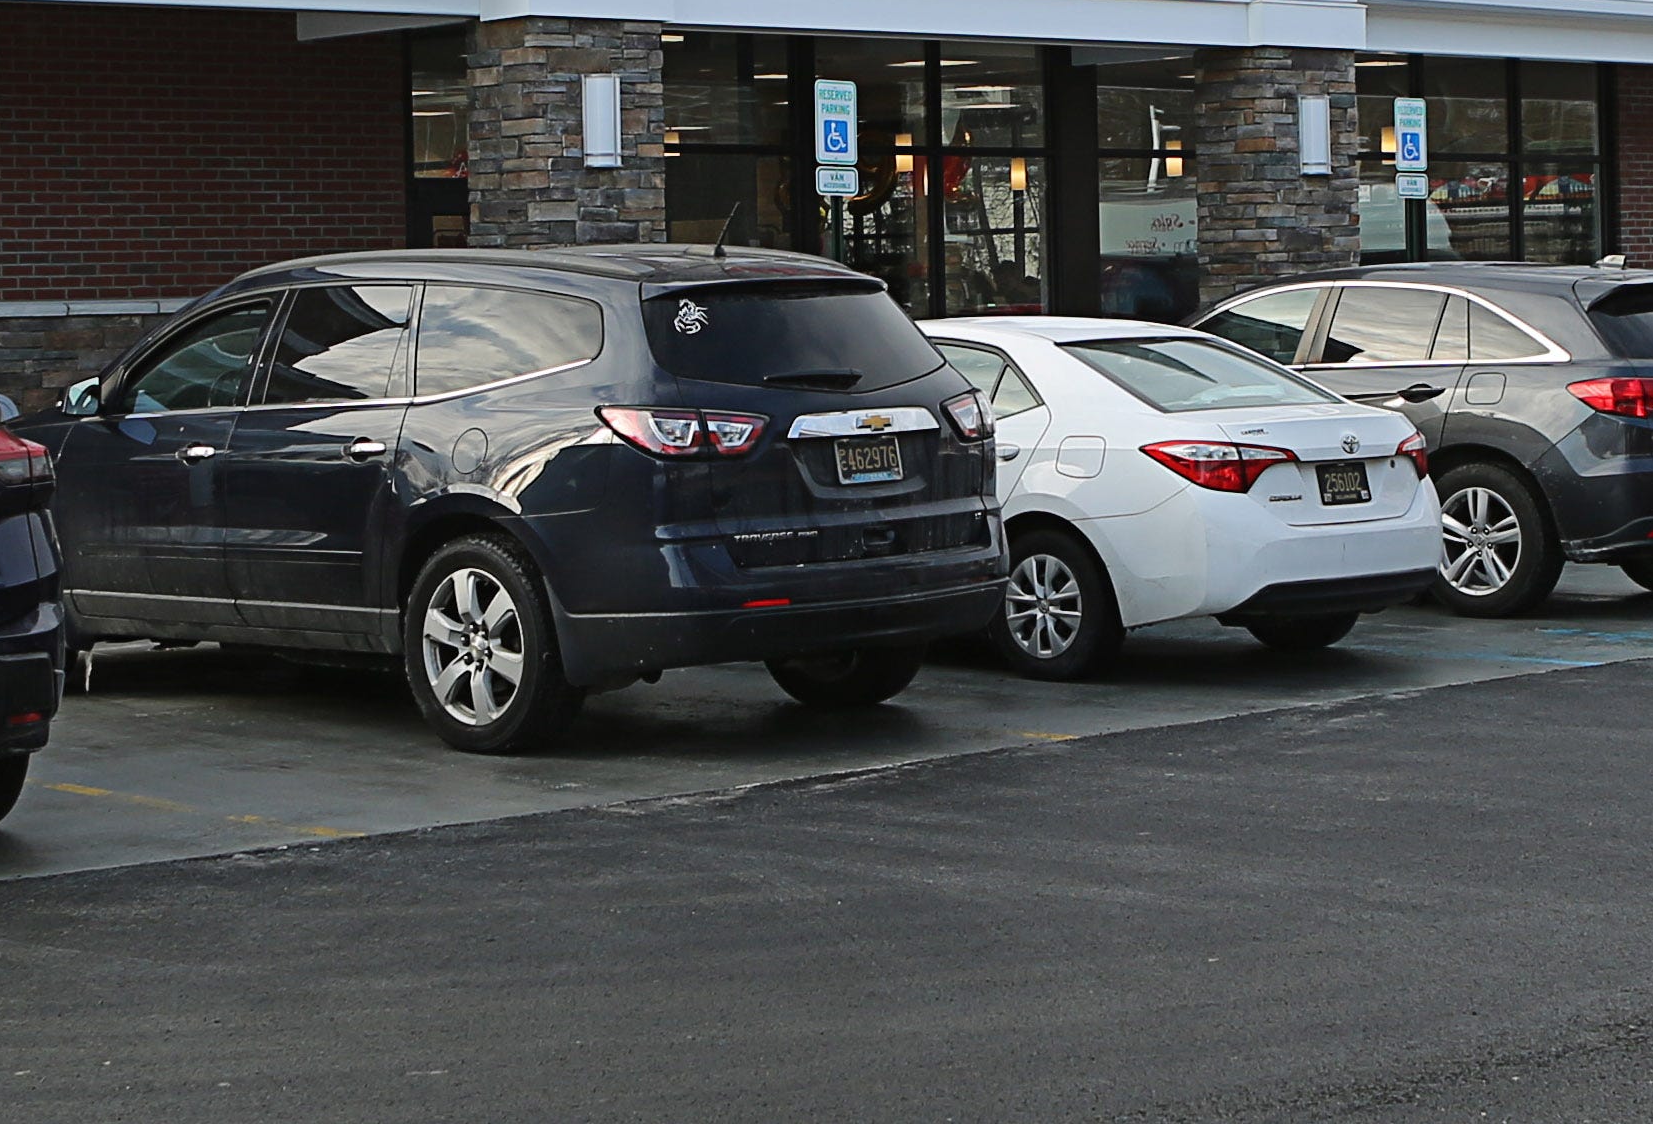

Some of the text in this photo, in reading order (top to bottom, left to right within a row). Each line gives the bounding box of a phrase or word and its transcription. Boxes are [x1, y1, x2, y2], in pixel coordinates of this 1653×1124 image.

[818, 89, 852, 101] RESERVED
[821, 103, 850, 115] PARKING
[830, 173, 845, 181] VAN
[848, 446, 898, 471] 462976
[1325, 472, 1362, 492] 256102
